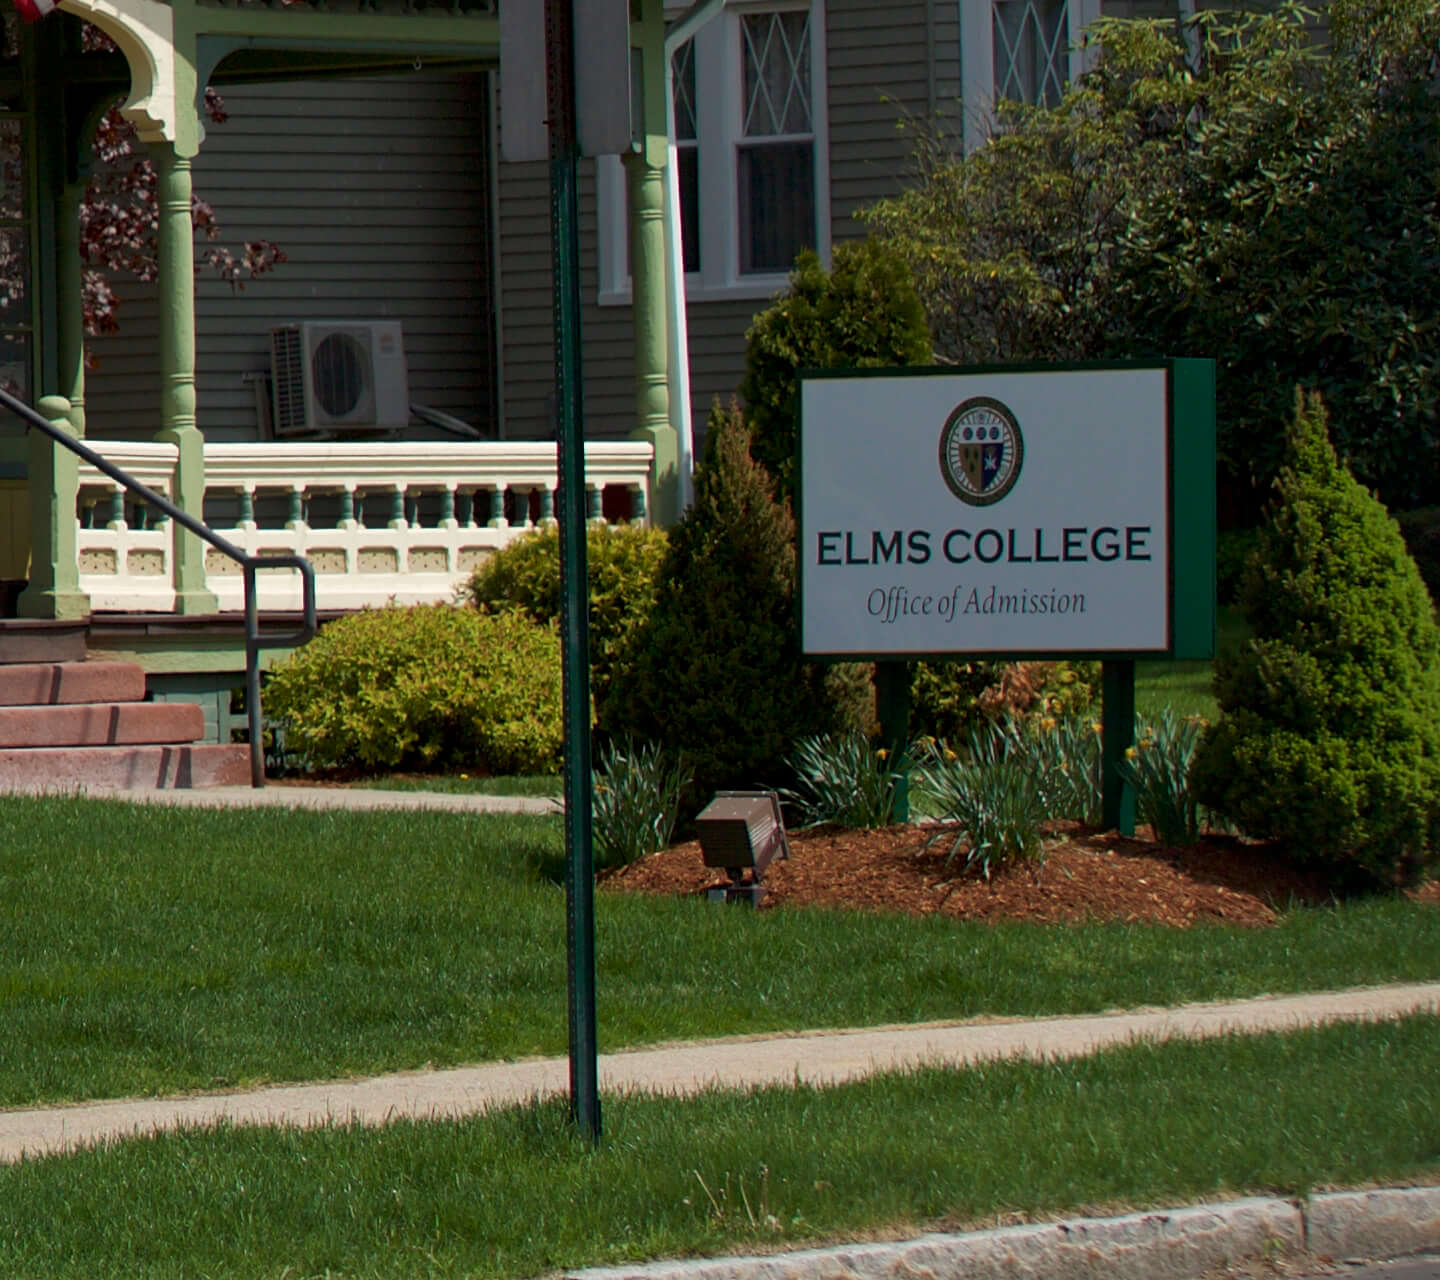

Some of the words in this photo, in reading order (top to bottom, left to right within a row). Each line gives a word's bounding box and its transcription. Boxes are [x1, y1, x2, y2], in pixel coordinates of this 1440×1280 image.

[816, 530, 932, 566] ELMS
[942, 526, 1152, 564] COLLEGE
[867, 585, 933, 624] Office
[937, 584, 963, 623] of
[963, 586, 1087, 616] Admission
